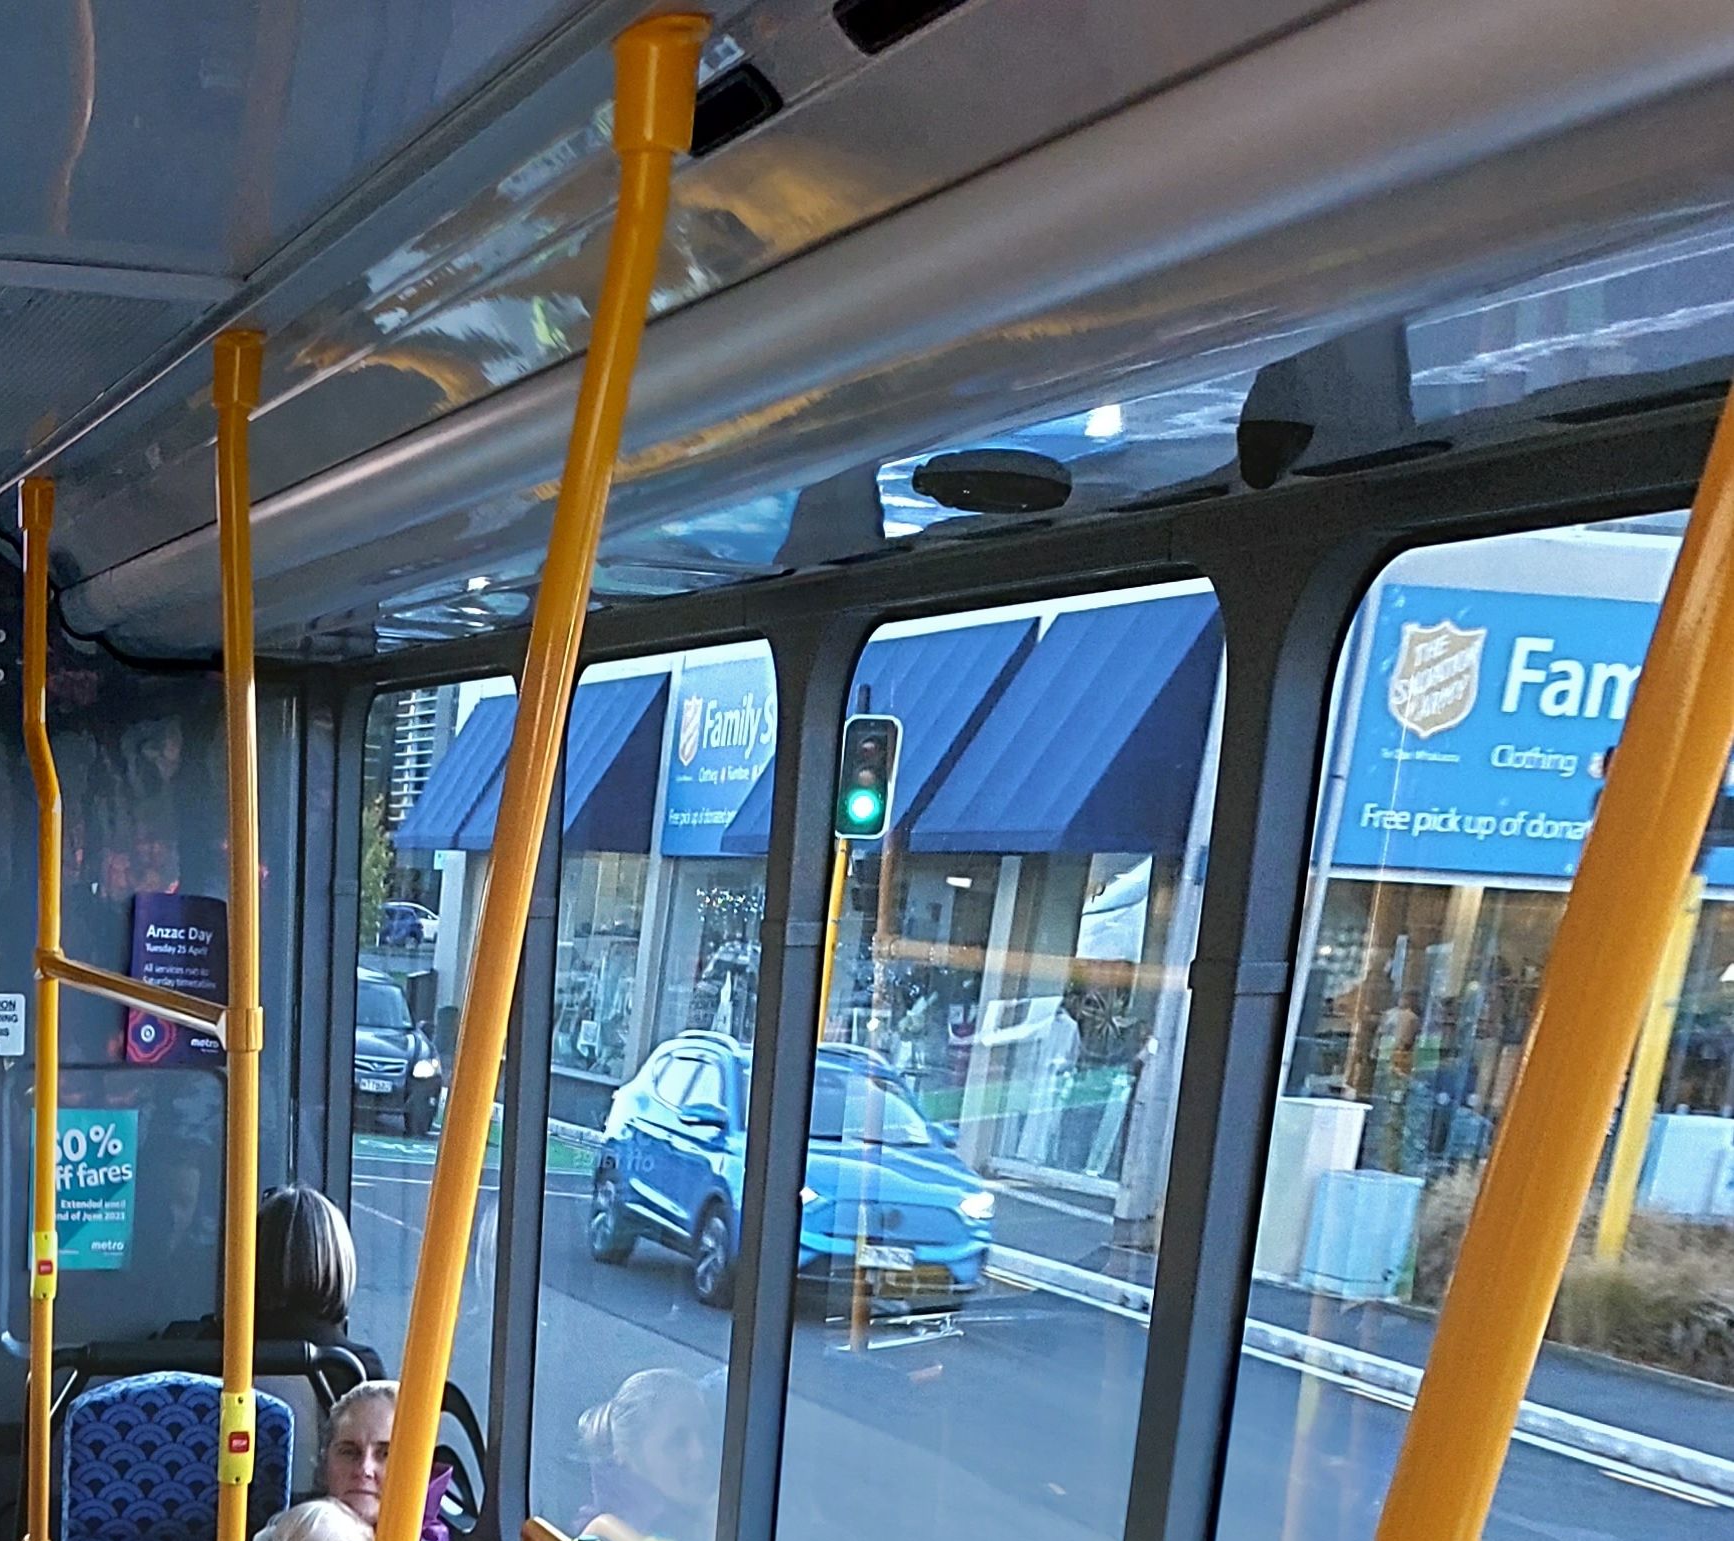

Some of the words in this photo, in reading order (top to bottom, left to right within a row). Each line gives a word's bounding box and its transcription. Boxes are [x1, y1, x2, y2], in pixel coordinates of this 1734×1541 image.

[703, 692, 762, 760] Family
[1490, 744, 1578, 778] Clothing
[1360, 803, 1410, 831] Free
[1411, 806, 1464, 837] pick
[1465, 815, 1497, 840] up
[1498, 810, 1529, 838] of
[146, 924, 185, 939] Anzac
[188, 927, 214, 945] Day
[145, 943, 176, 955] Tuesday
[77, 1163, 133, 1188] fares
[61, 1200, 103, 1209] Extended
[70, 1211, 81, 1221] of
[91, 1240, 124, 1251] metro
